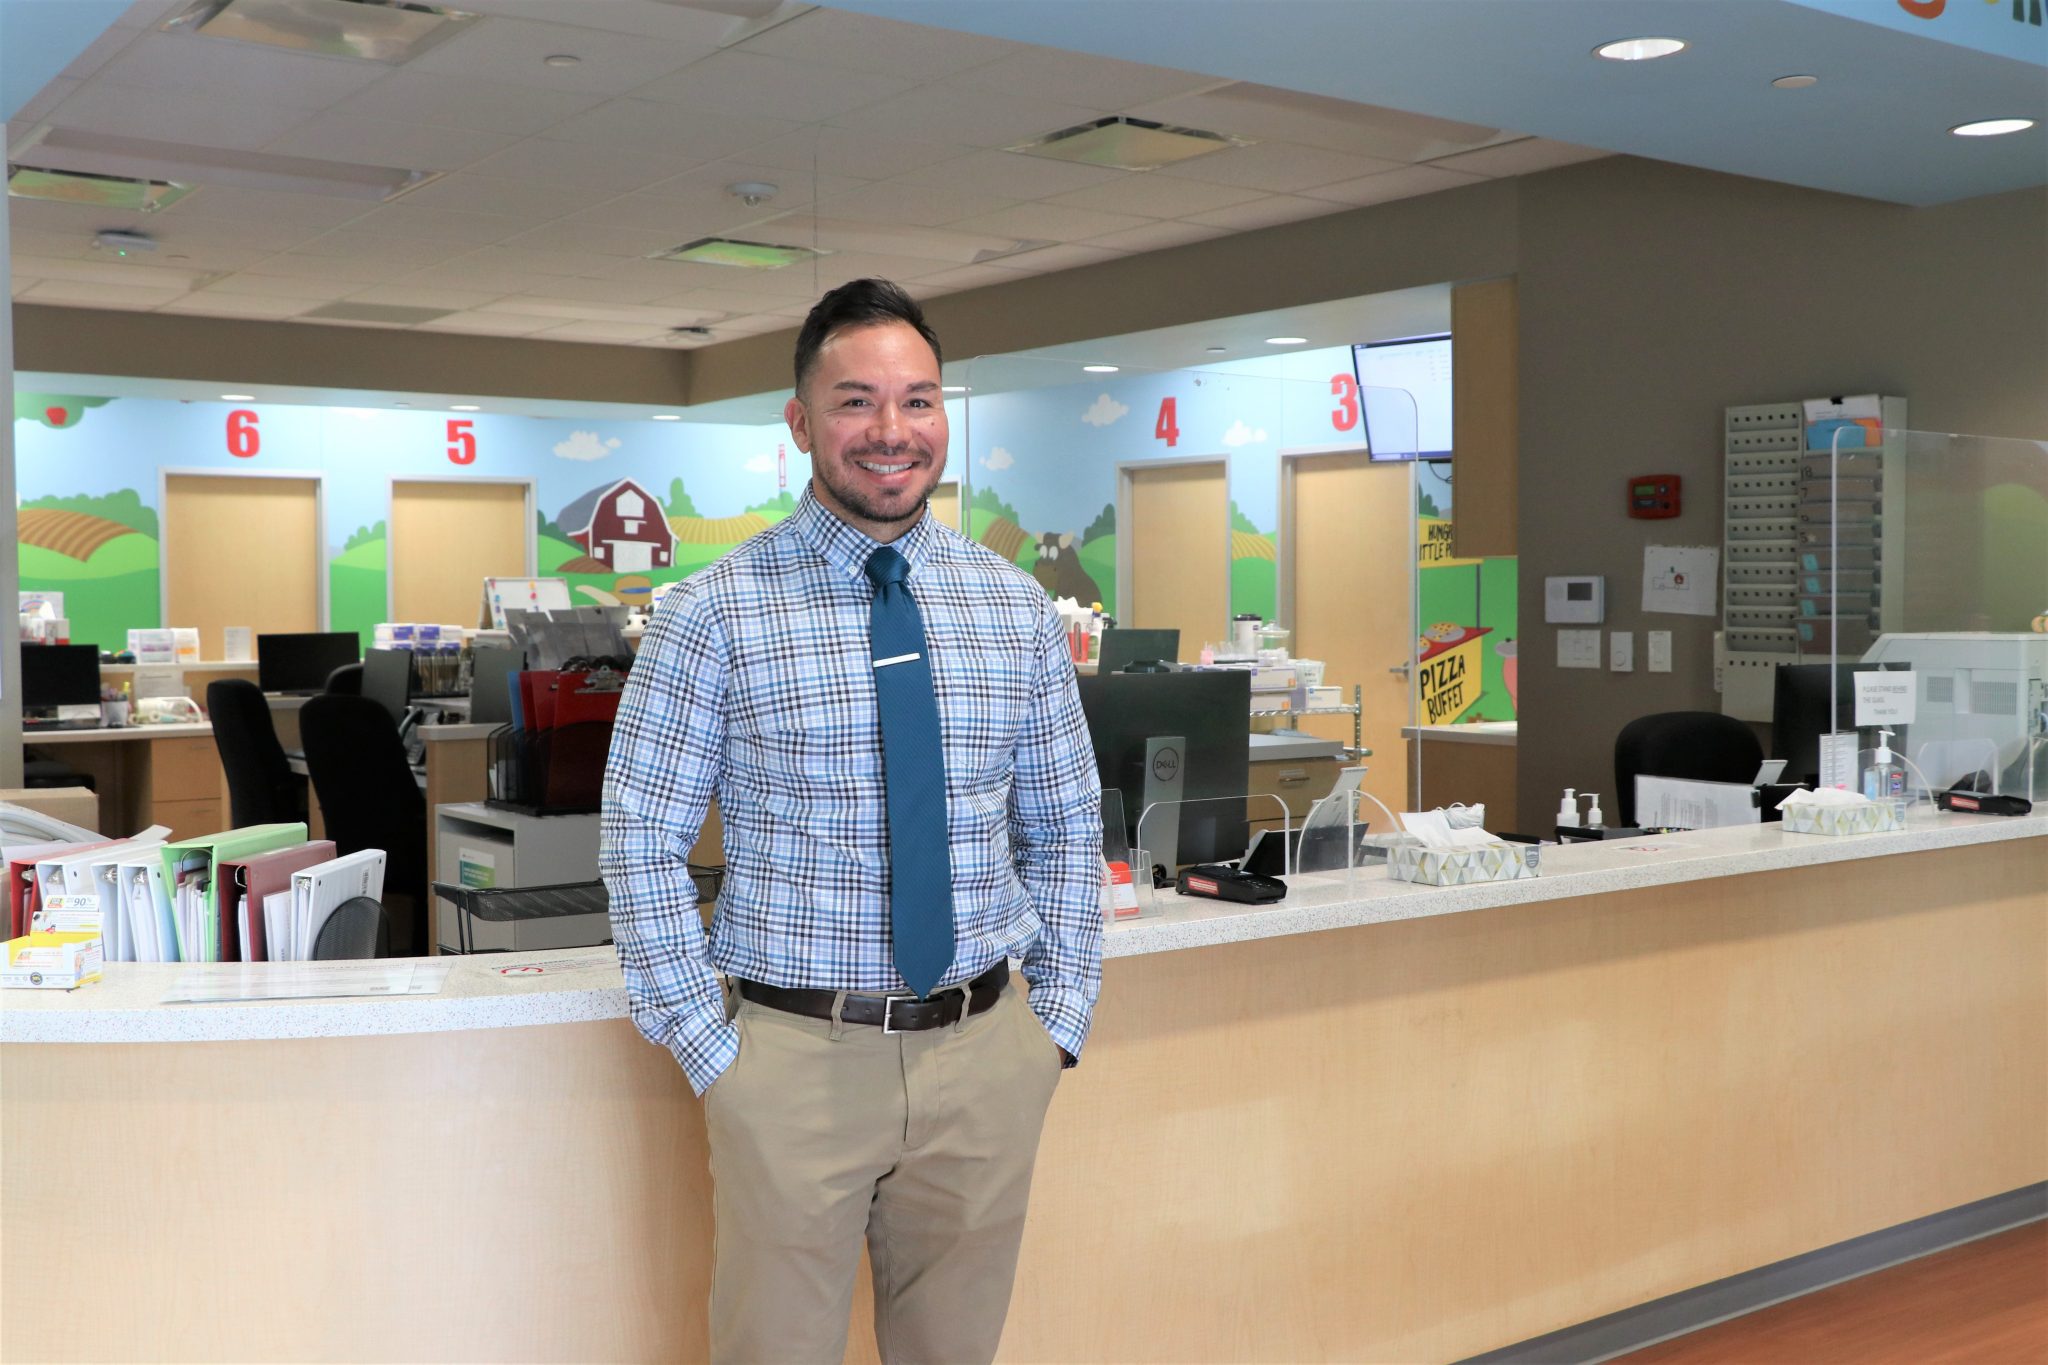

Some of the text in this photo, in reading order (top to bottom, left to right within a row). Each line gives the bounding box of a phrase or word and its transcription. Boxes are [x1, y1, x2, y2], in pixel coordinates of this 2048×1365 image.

[1155, 397, 1180, 447] 4
[1331, 373, 1359, 432] 3
[226, 409, 260, 458] 6
[447, 420, 476, 465] 5
[1419, 542, 1445, 561] ITTLE
[1428, 523, 1454, 541] HUNGR
[1420, 655, 1465, 700] PIZZA
[1427, 681, 1463, 724] BUFFET
[1156, 760, 1176, 768] DELL
